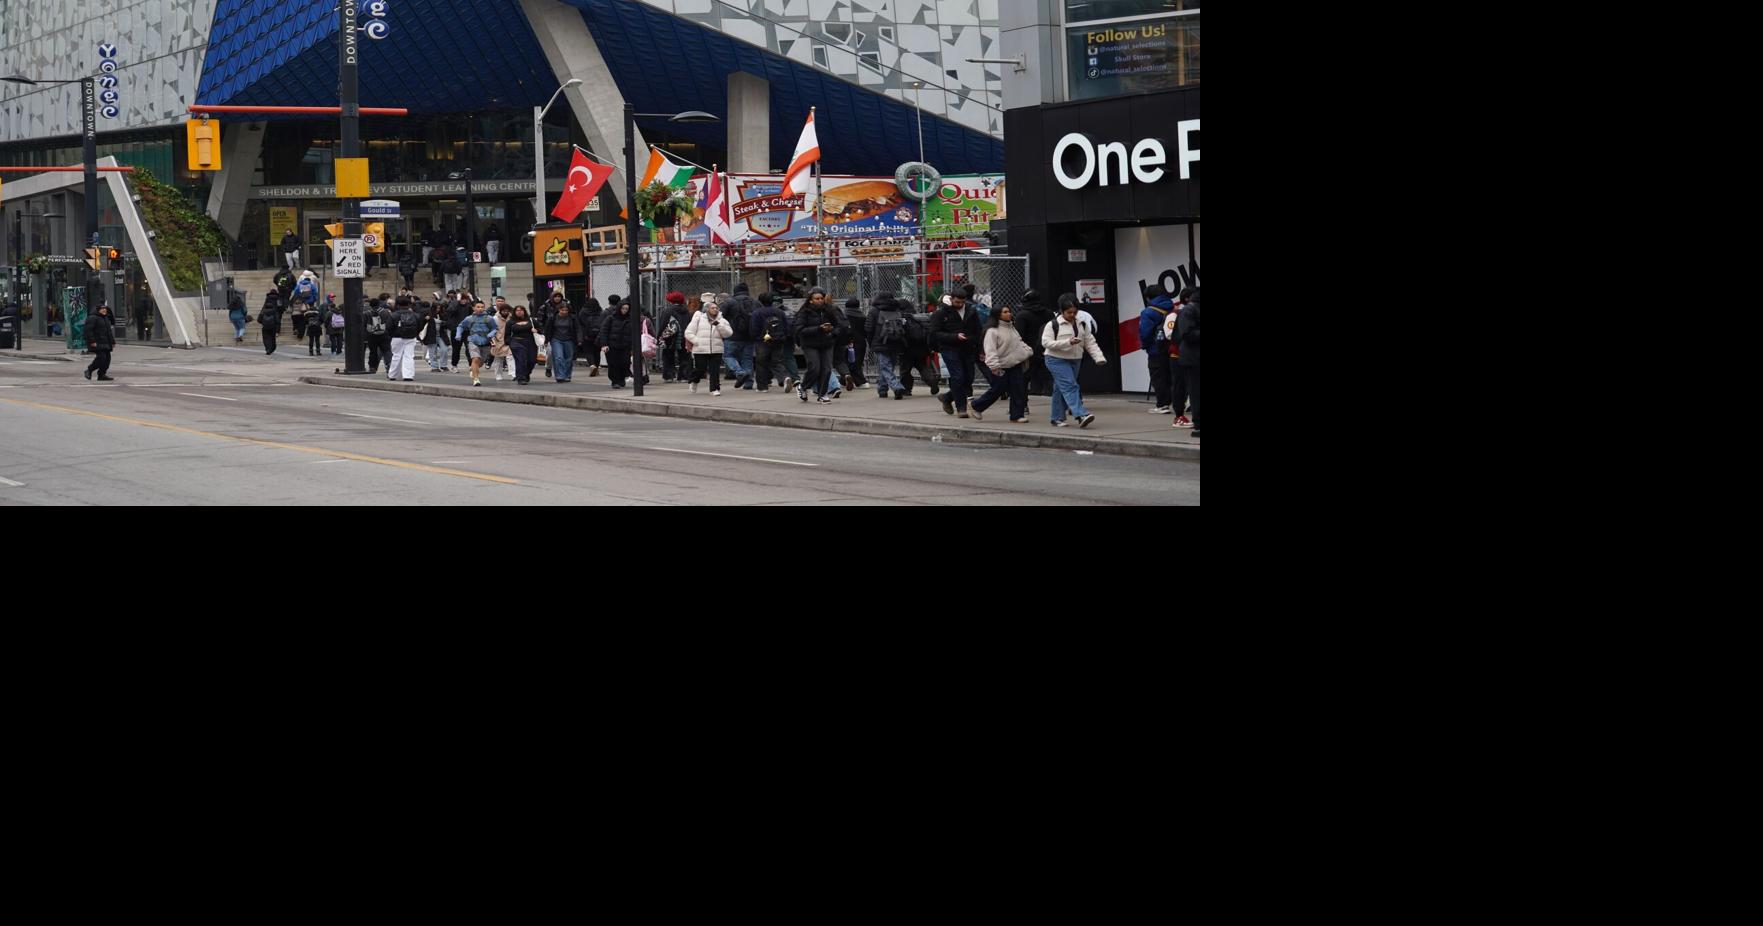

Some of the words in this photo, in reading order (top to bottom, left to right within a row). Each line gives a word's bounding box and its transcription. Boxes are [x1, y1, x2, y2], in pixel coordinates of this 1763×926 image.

[1087, 29, 1137, 44] Follow
[1142, 24, 1166, 38] Us!
[1132, 54, 1152, 62] Store
[99, 43, 119, 119] Yonge
[86, 82, 95, 137] DOWNTOWN
[1053, 133, 1166, 190] One
[259, 187, 310, 197] SHELDON
[312, 187, 321, 195] &
[389, 184, 440, 194] STUDENT
[499, 182, 537, 191] CENTR
[734, 202, 759, 216] Steak
[760, 200, 770, 208] &
[830, 224, 877, 235] Original
